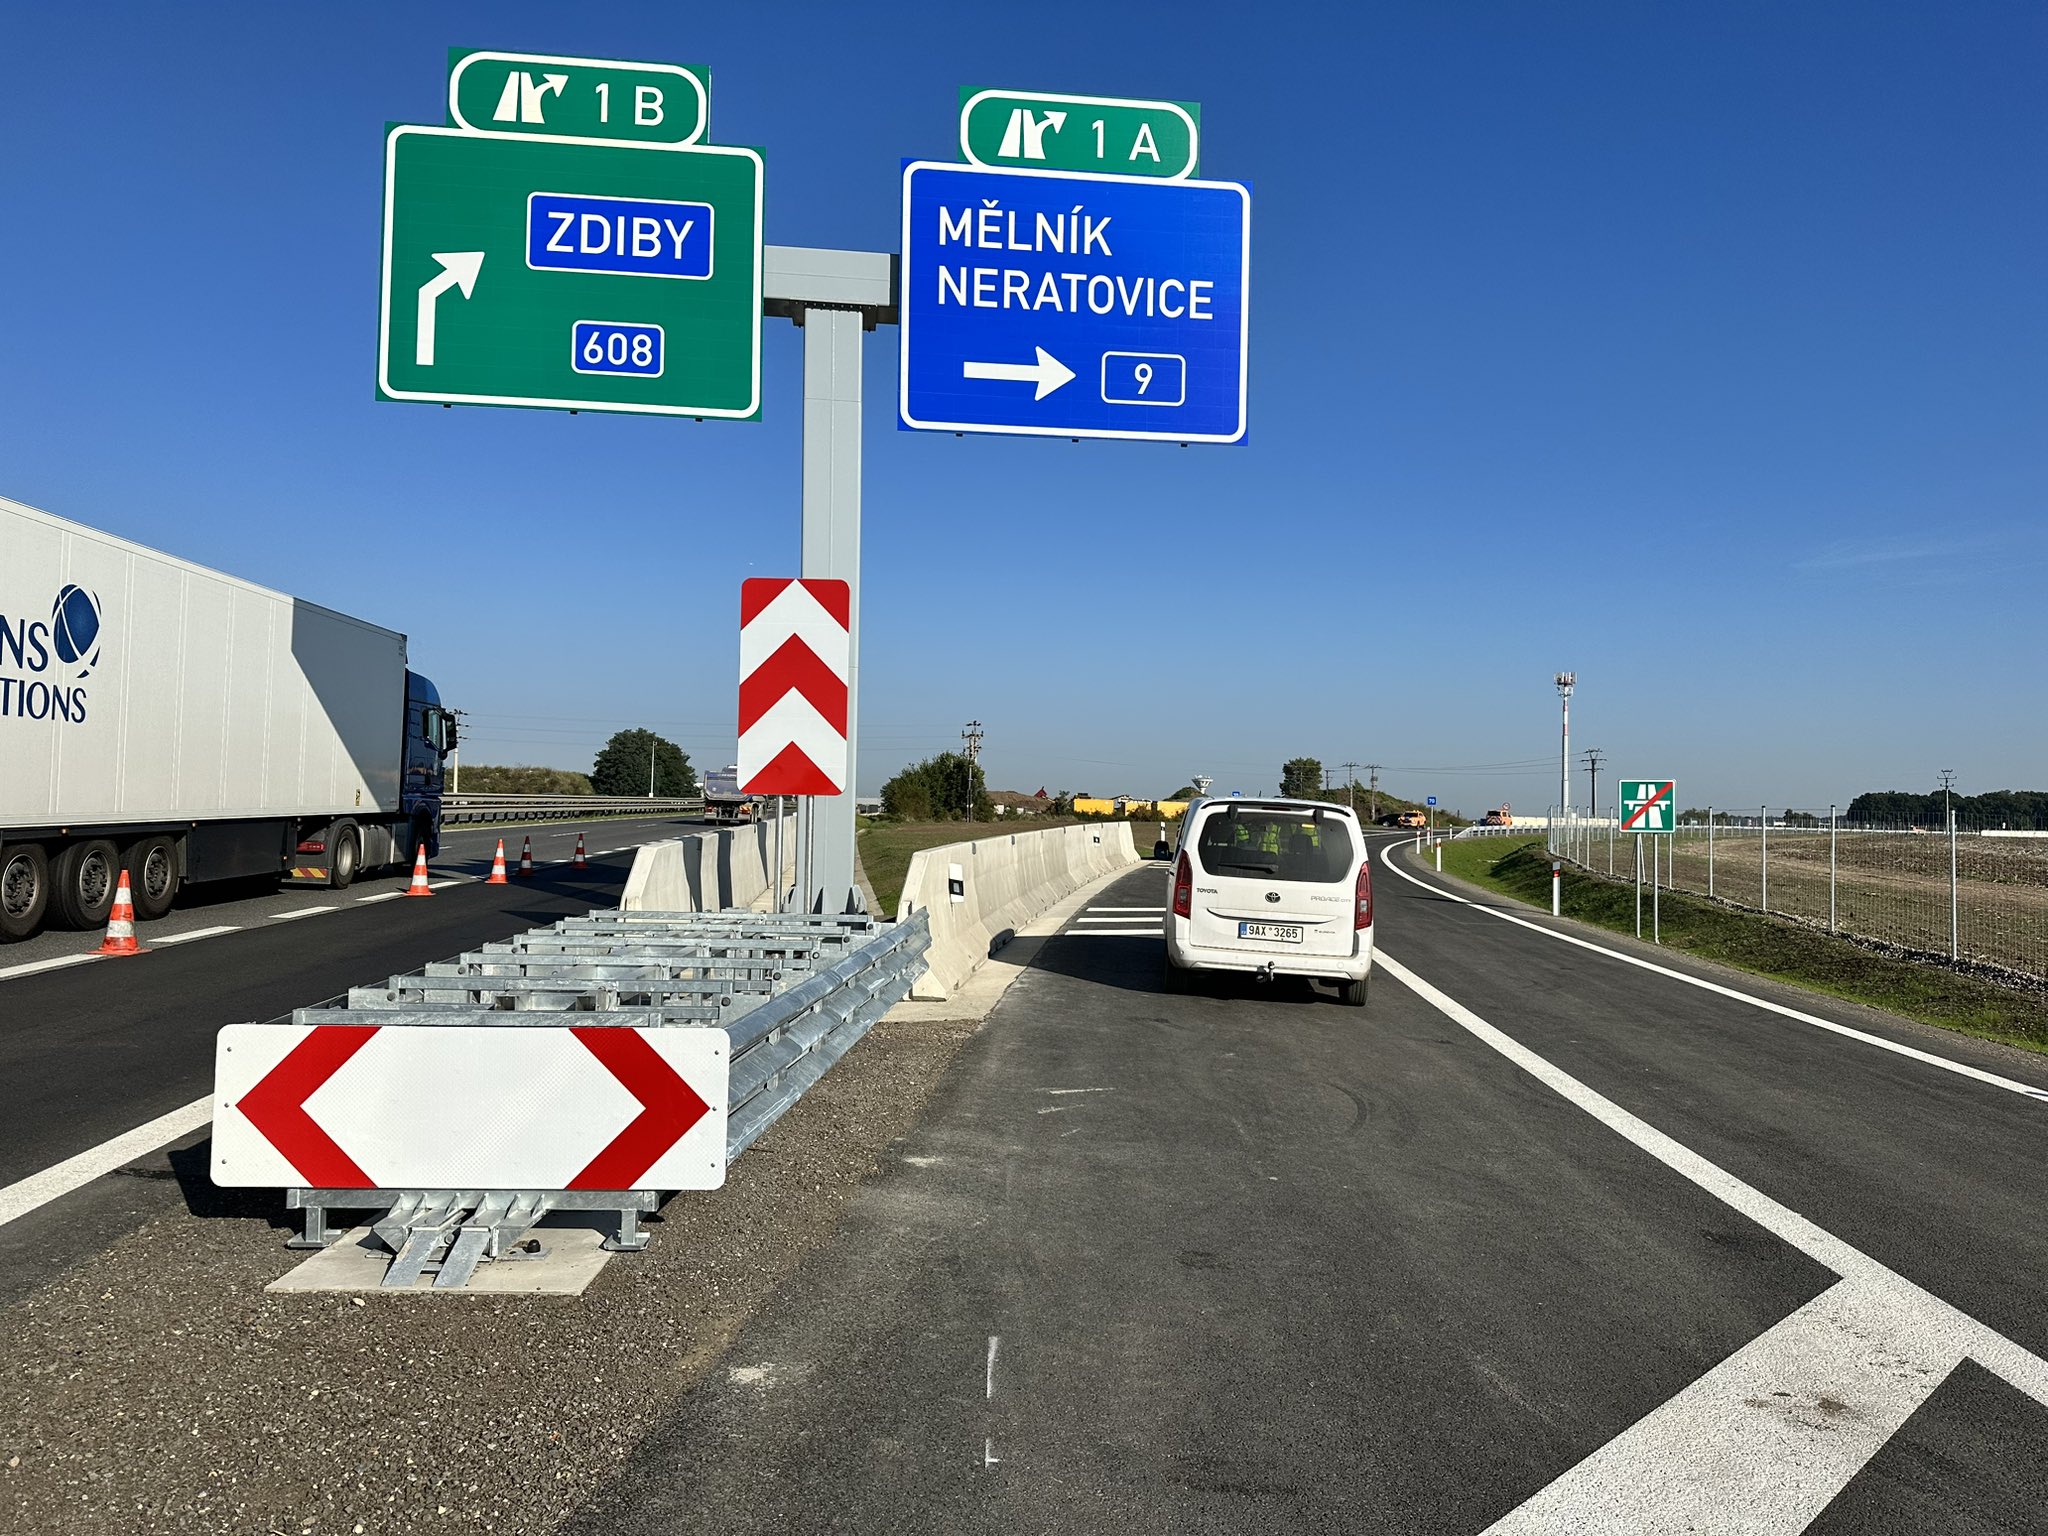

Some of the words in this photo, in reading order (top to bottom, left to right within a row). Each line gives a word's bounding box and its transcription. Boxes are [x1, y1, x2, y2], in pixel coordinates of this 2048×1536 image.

[595, 83, 609, 123] 1
[634, 85, 664, 126] B
[1092, 119, 1104, 159] 1
[1128, 122, 1161, 163] A
[546, 211, 694, 260] ZDIBY
[938, 199, 1113, 256] MĚLNÍK
[938, 265, 1214, 320] NERATOVICE
[583, 331, 653, 367] 608
[1134, 362, 1153, 395] 9
[1248, 925, 1267, 936] 9AX
[1273, 927, 1298, 939] 3265
